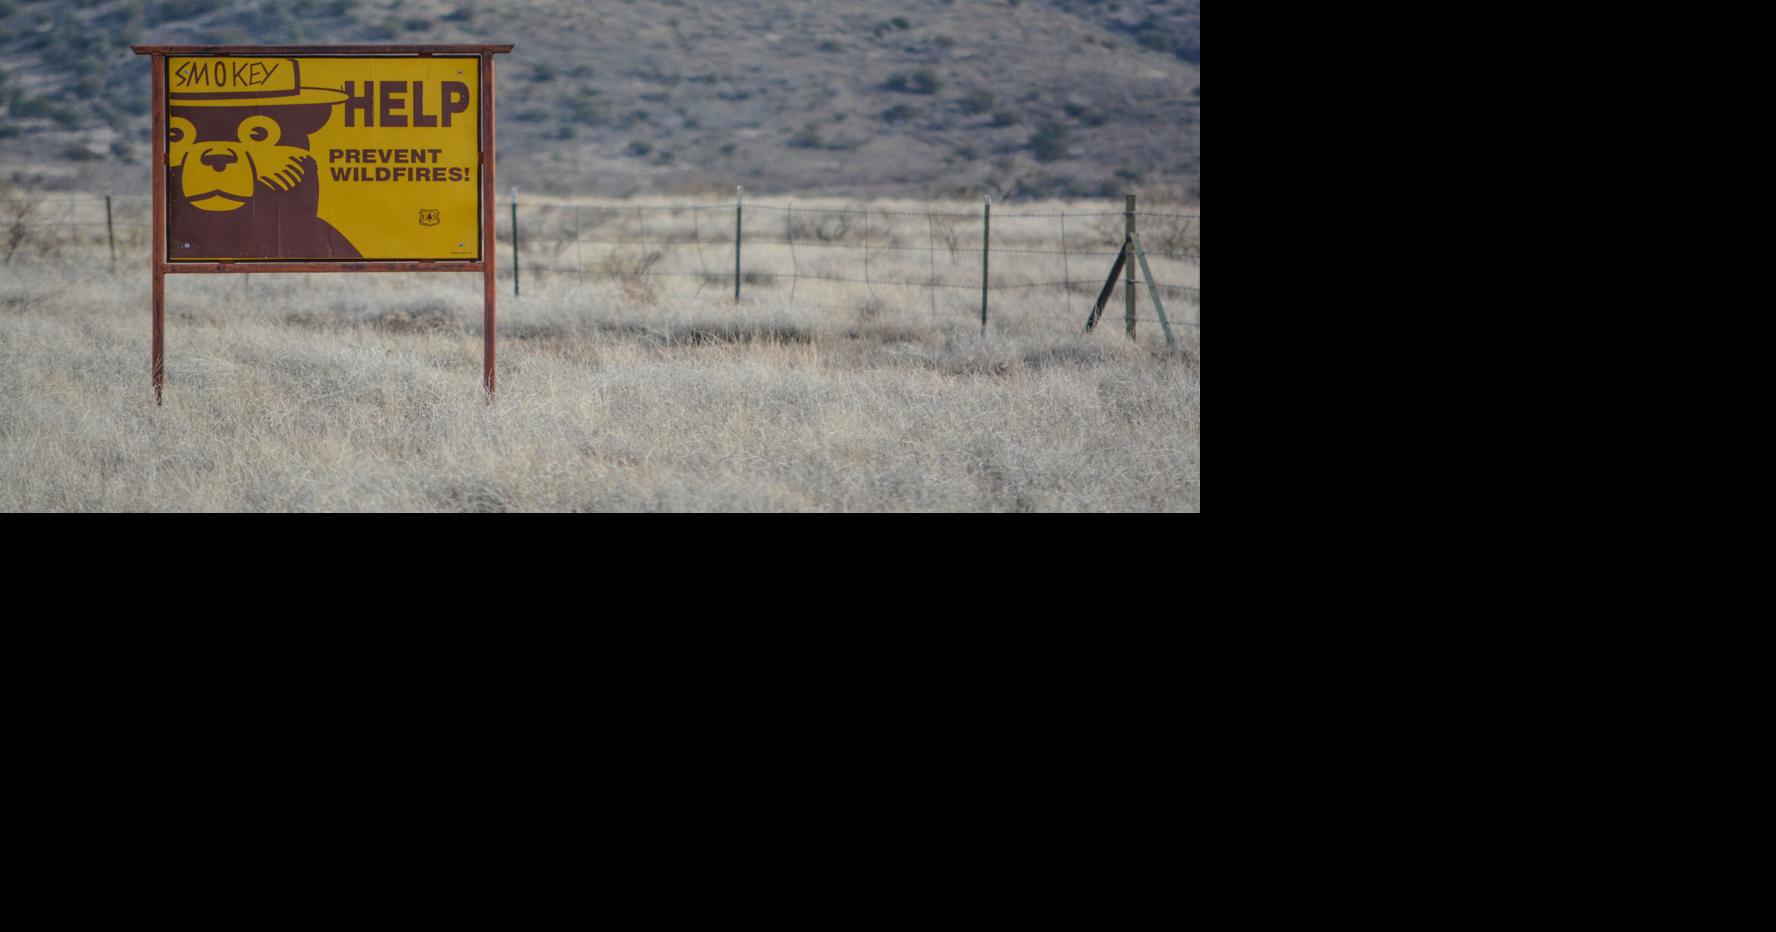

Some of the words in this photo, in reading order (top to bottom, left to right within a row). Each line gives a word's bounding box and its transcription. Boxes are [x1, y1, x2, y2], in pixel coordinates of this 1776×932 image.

[174, 61, 279, 87] SMOKEY
[344, 80, 470, 127] HELP
[329, 149, 442, 163] PREVENT
[330, 167, 470, 182] WILDFIRES!
